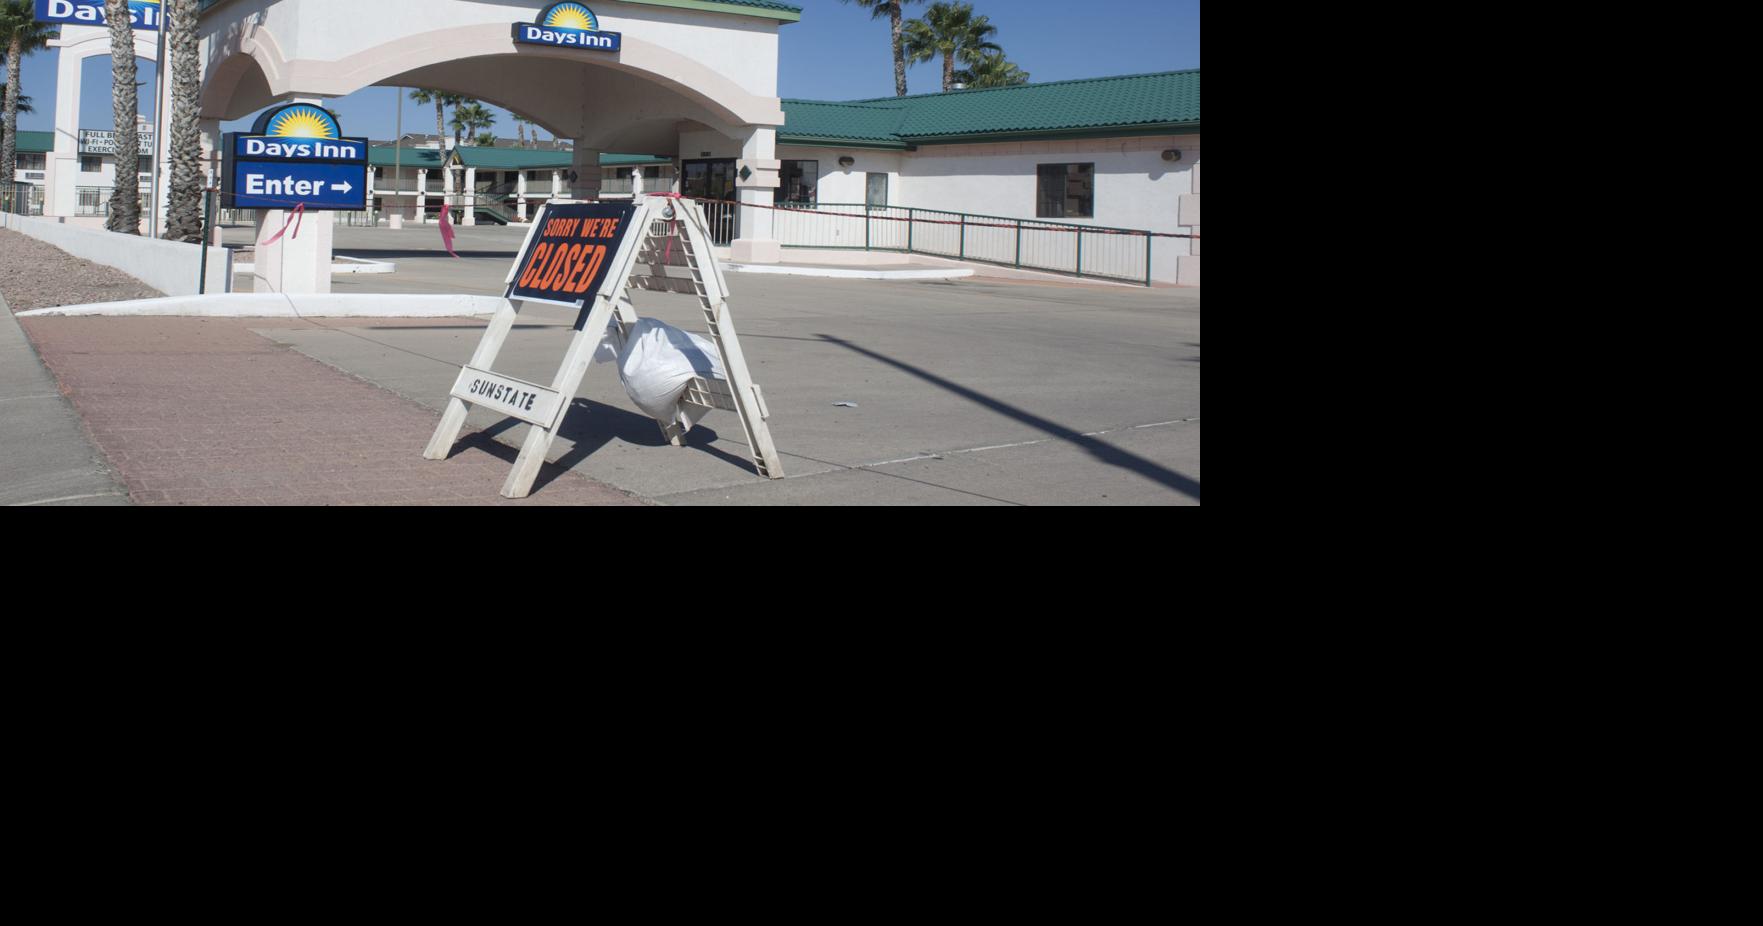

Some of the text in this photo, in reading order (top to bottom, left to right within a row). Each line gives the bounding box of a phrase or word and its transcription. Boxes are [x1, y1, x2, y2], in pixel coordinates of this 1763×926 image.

[527, 26, 612, 48] Days Inn
[246, 139, 356, 158] Days Inn
[246, 173, 325, 196] Enter
[543, 218, 619, 238] SORRY WE'RE
[518, 242, 607, 293] CLOSED
[470, 379, 537, 411] SUNSTATE
